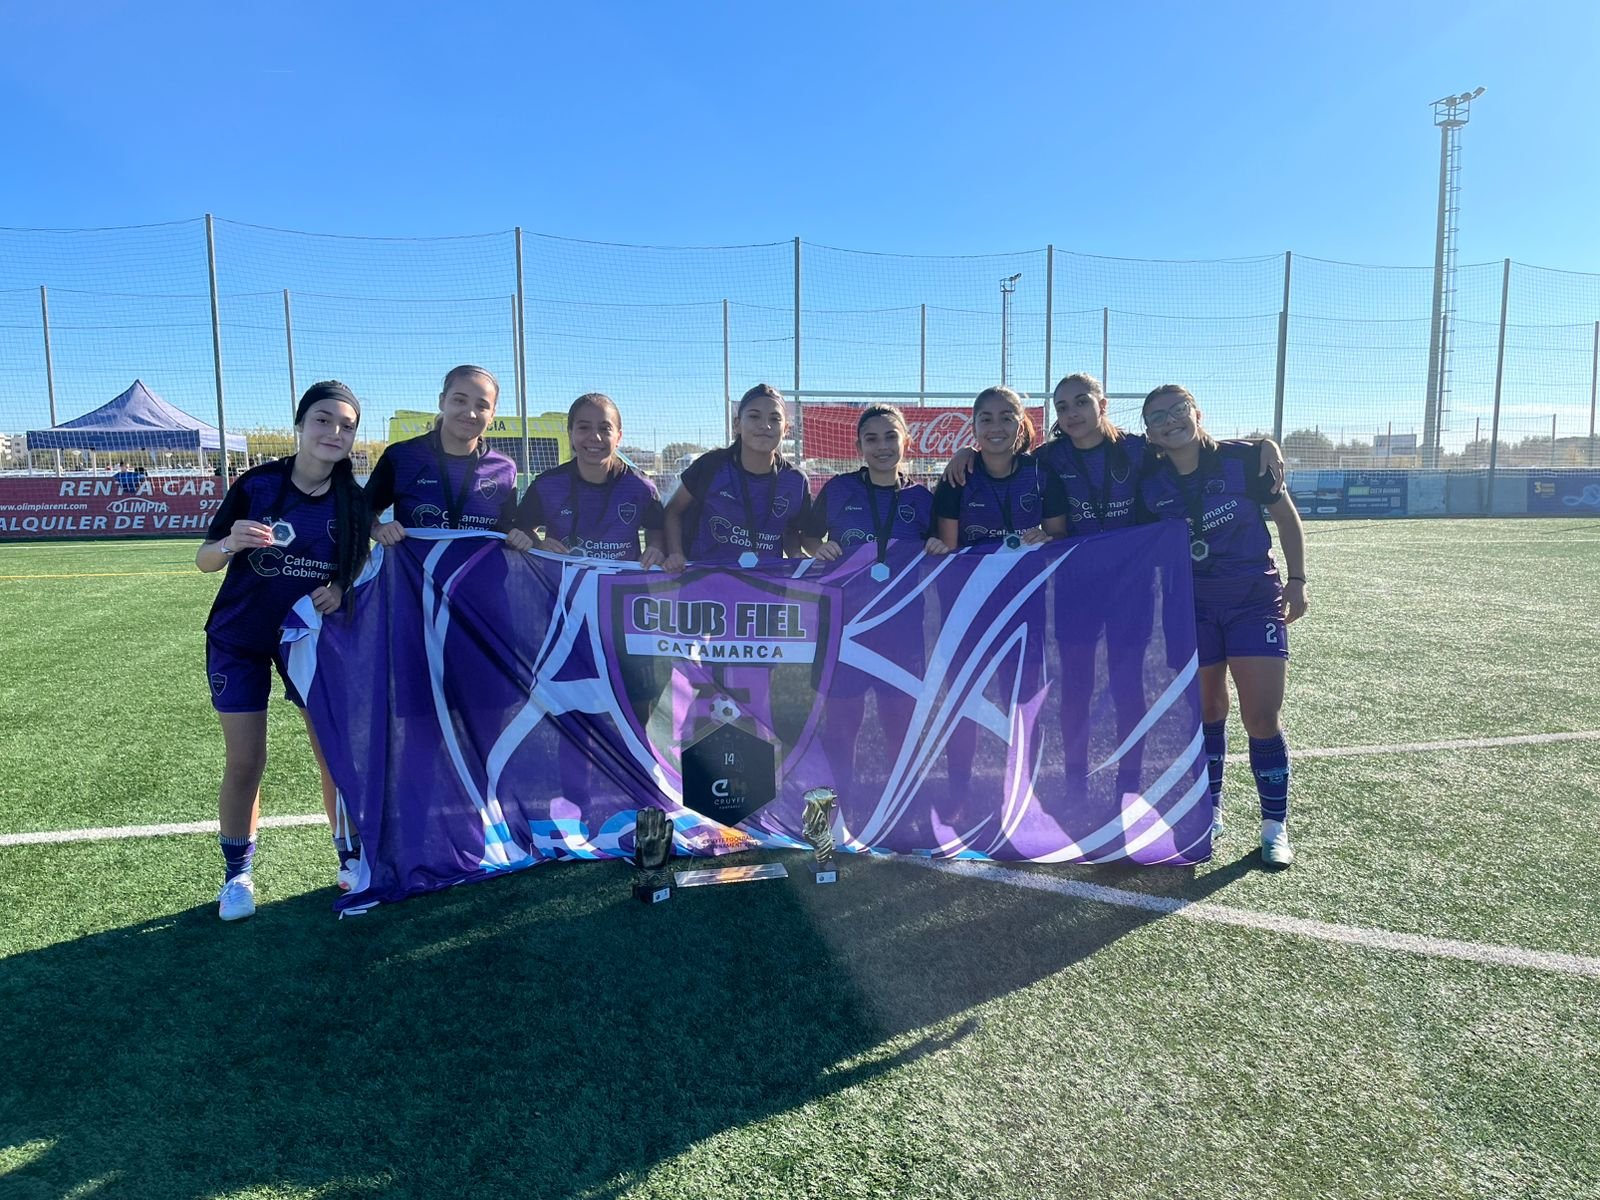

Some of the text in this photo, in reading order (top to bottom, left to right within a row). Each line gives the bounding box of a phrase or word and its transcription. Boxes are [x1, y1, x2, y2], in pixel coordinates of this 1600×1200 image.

[59, 480, 216, 497] RENT A CAR
[112, 501, 168, 513] OLIMPIA
[114, 515, 146, 530] DE
[632, 596, 807, 639] CLUB FIEL
[1265, 622, 1278, 644] 2
[657, 639, 784, 659] CATAMARCA
[724, 752, 735, 766] 14
